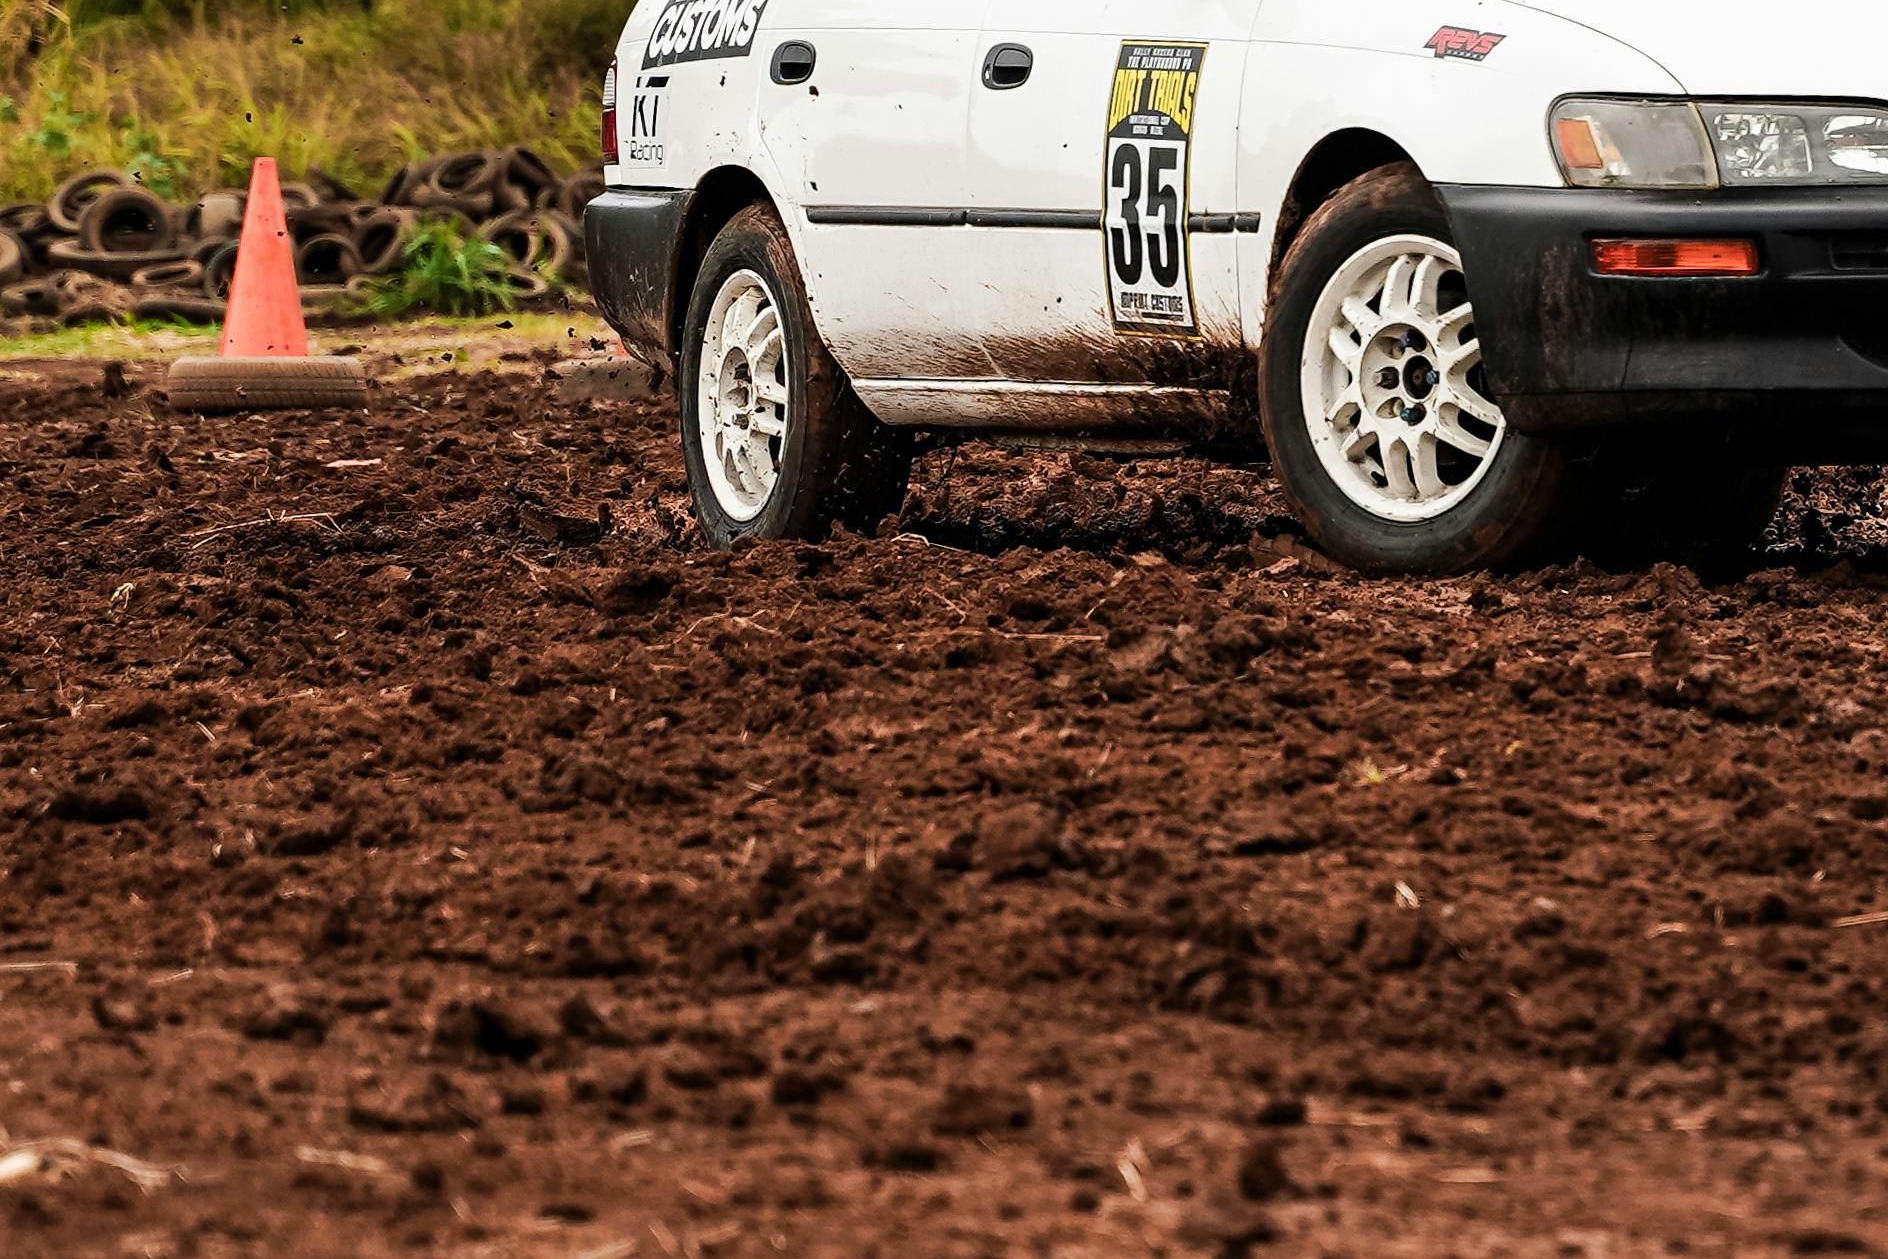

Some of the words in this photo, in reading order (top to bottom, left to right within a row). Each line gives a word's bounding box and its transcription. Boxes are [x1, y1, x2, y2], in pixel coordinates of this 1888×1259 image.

[1109, 69, 1147, 132] DIRT
[1148, 70, 1197, 134] TRIALS
[1110, 143, 1179, 288] 35
